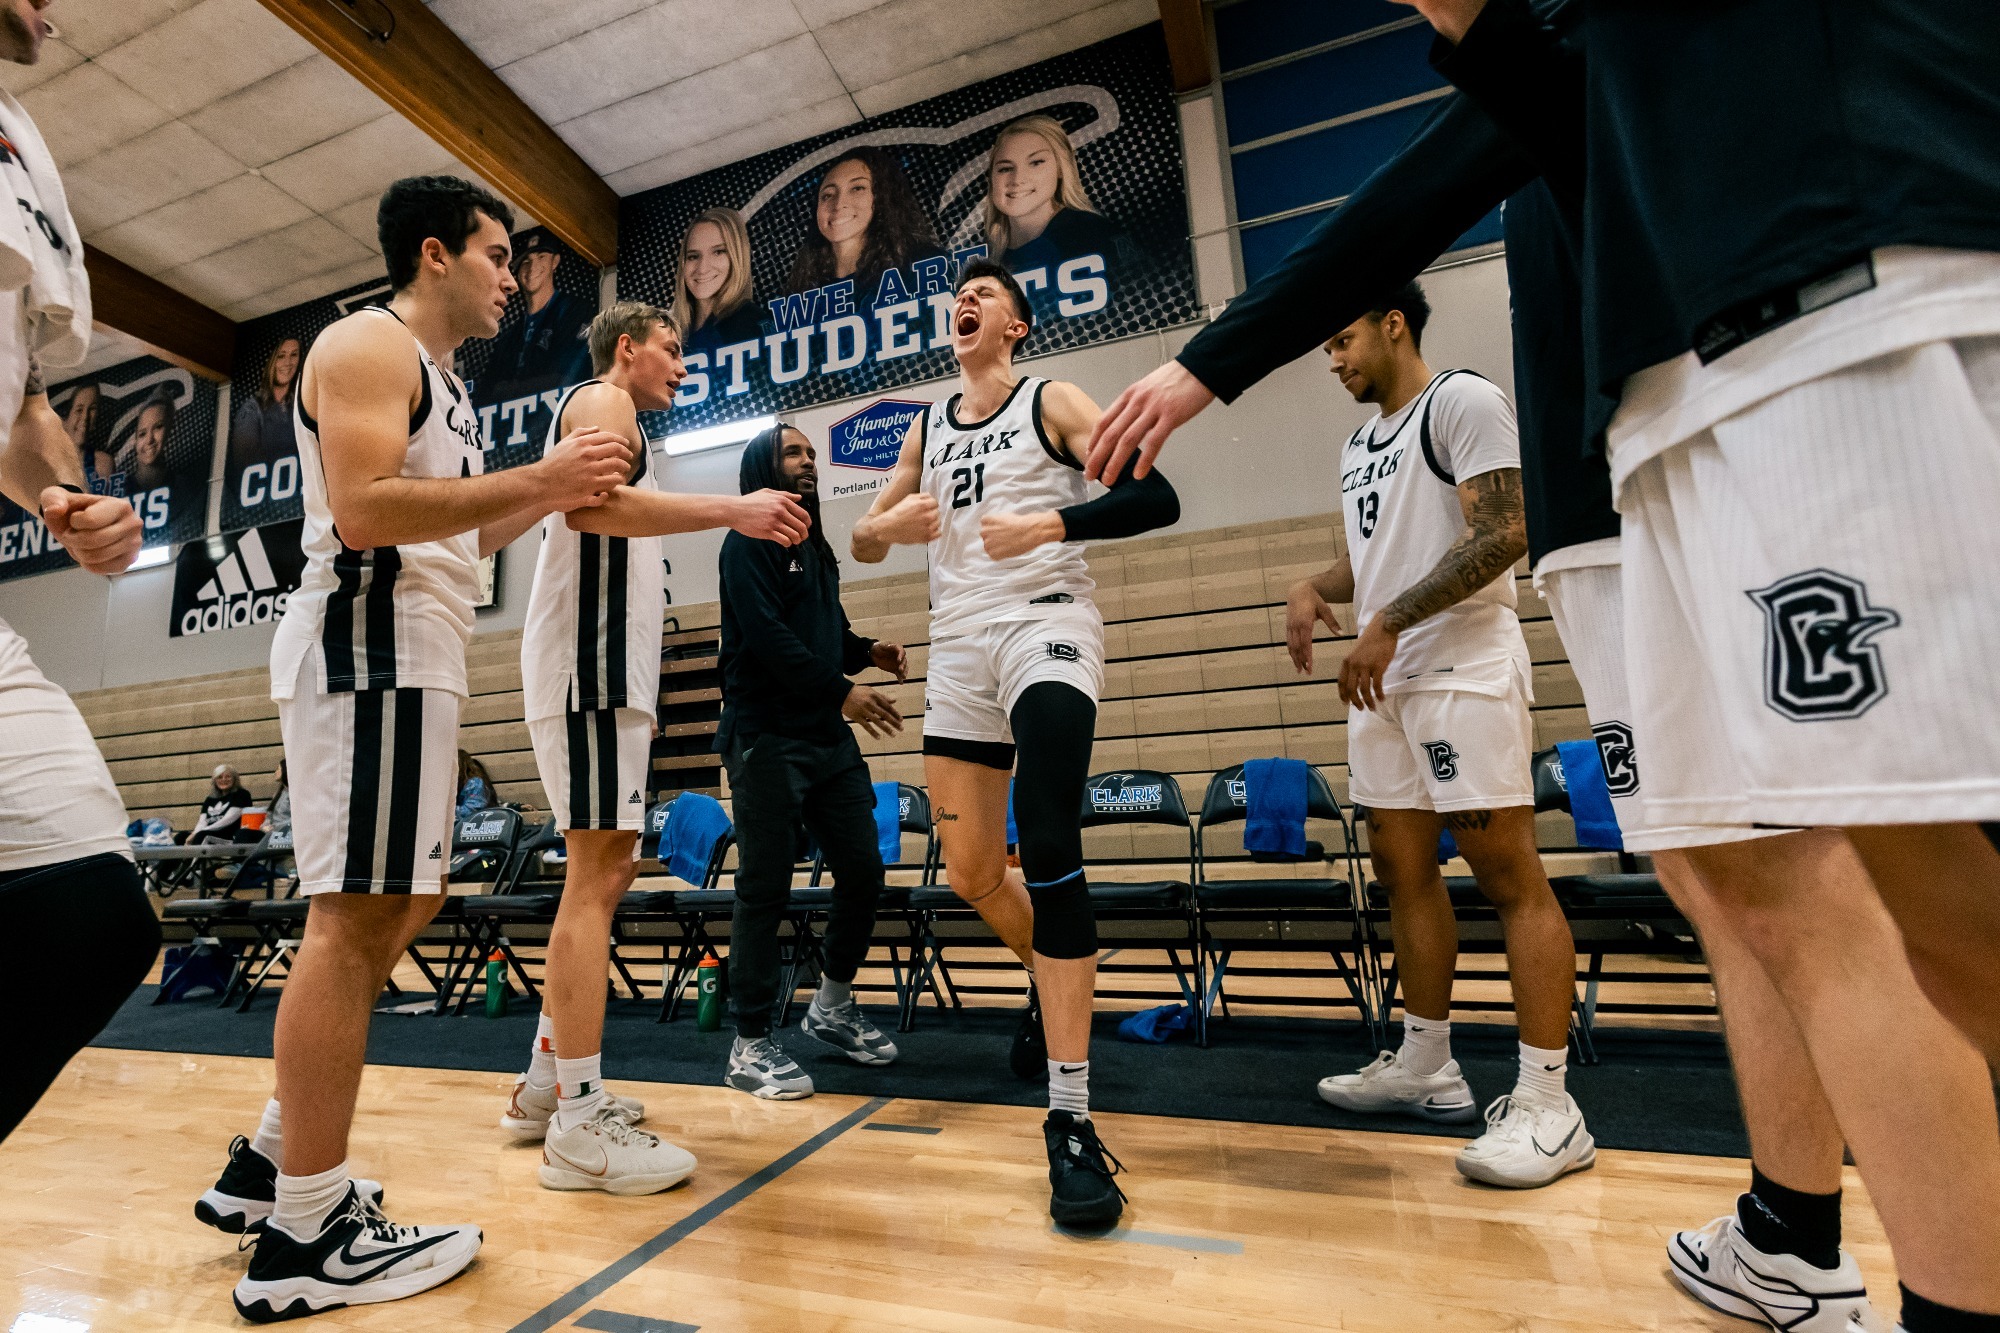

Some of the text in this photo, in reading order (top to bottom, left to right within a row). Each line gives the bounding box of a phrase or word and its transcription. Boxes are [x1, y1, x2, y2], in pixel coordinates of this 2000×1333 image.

[768, 280, 854, 333] WE
[844, 411, 915, 439] Hampton
[875, 450, 900, 460] HILTO
[930, 430, 1020, 469] CLARK
[833, 479, 876, 495] Portland
[952, 463, 984, 509] 21
[1342, 448, 1404, 493] CLARK
[1358, 491, 1379, 540] 13
[181, 589, 289, 636] adidas
[1091, 785, 1162, 804] CLARK
[702, 977, 717, 994] G
